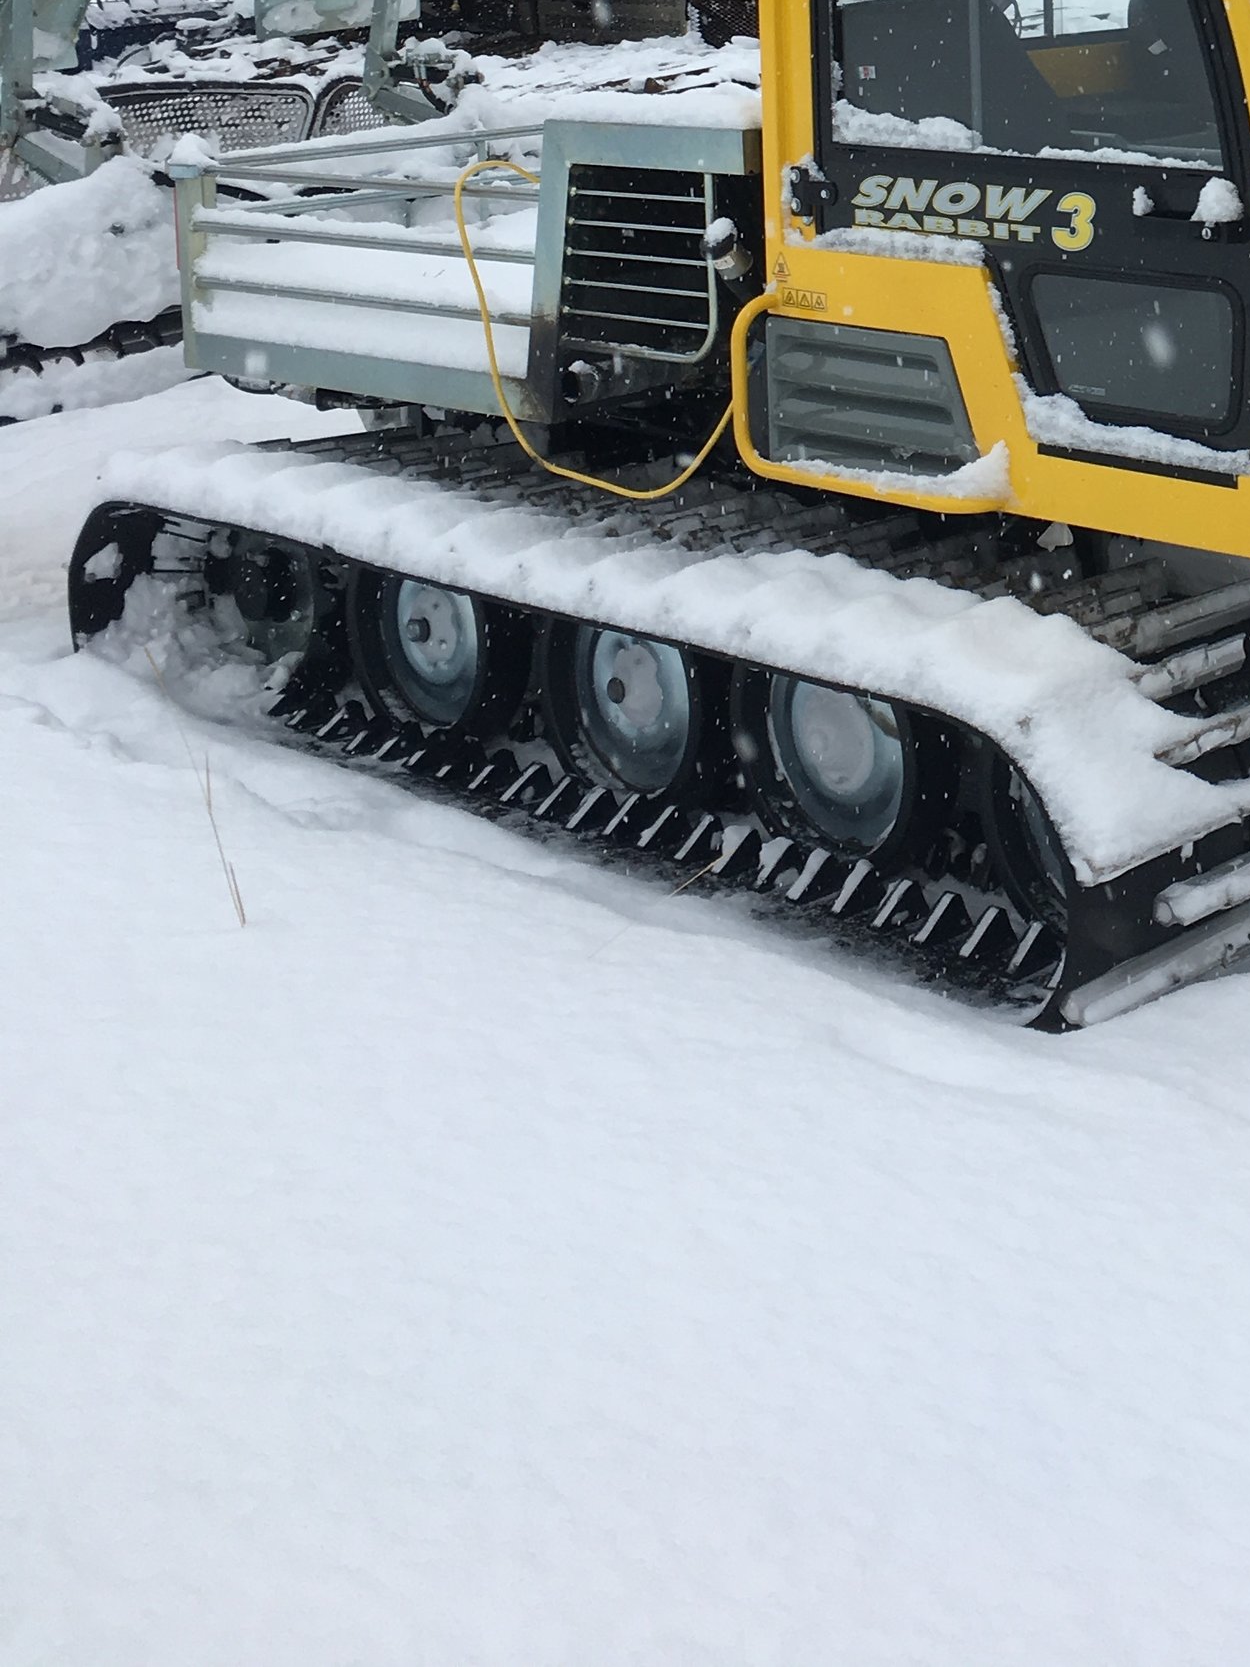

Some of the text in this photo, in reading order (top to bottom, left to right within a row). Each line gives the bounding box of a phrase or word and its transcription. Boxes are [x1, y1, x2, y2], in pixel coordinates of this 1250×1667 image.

[851, 175, 1096, 251] SNOW 3
[854, 209, 1041, 242] RABBIT
